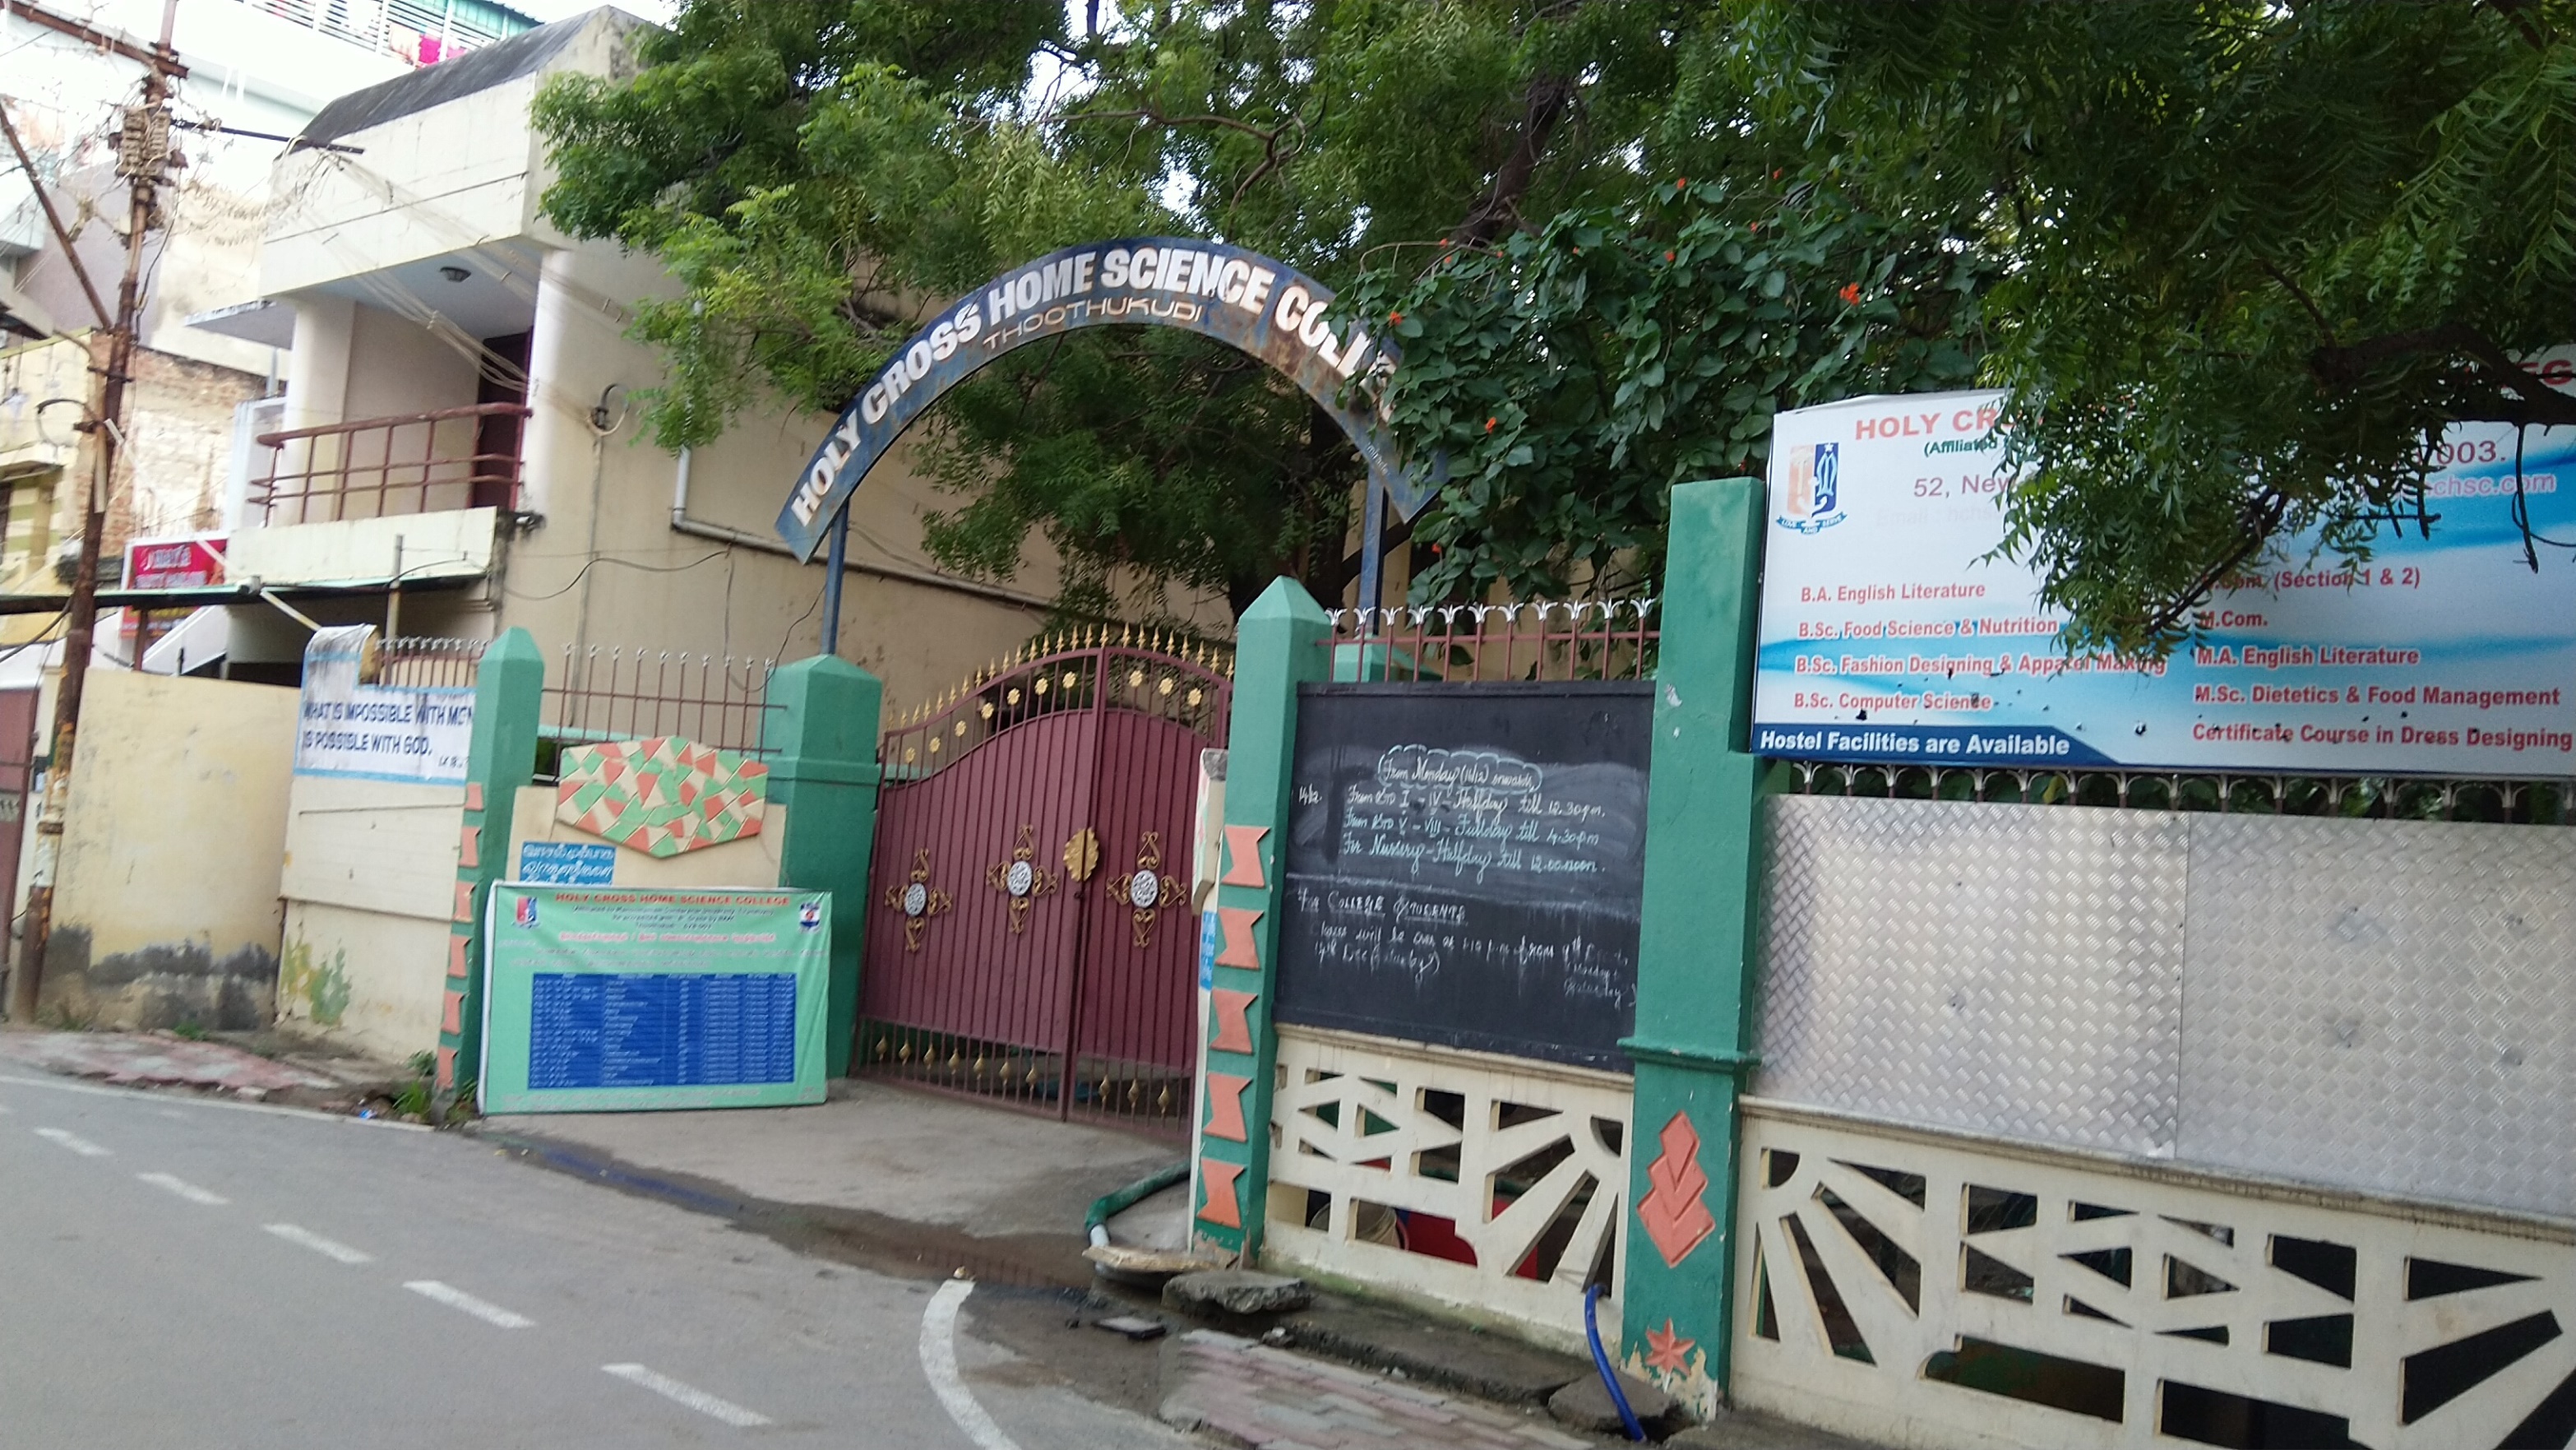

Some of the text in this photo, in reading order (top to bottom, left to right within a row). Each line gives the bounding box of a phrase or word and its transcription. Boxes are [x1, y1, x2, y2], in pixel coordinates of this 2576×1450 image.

[983, 297, 1203, 350] THOOTHUKUDI
[791, 409, 861, 526] HOLY
[862, 302, 982, 424] CROSS
[988, 251, 1097, 327] HOME
[1101, 247, 1275, 315] SCIENCE
[1855, 413, 1941, 440] HOLY
[1914, 477, 1949, 498] 52,
[2274, 570, 2354, 591] (Section
[2380, 568, 2393, 586] &
[2402, 567, 2421, 589] 2)
[1801, 583, 1986, 605] B.A. English Literature
[1799, 617, 2058, 637] B.Sc. Food Science & Nutrition
[2199, 610, 2268, 628] M.Com.
[1797, 657, 1836, 673] B.Sc.
[1842, 656, 1903, 672] Fashion
[1910, 656, 1993, 675] Designing
[2000, 655, 2012, 671] &
[2197, 647, 2419, 669] M.A. English Literature
[1794, 692, 1991, 711] B.Sc. Computer Science
[2195, 685, 2560, 709] M.Sc. Dietetics & Food Management
[303, 702, 331, 720] WHAT
[334, 702, 342, 720] IS
[345, 702, 413, 724] IMPOSSIBLE
[415, 705, 444, 725] WITH
[302, 731, 312, 749] IS
[315, 732, 368, 753] POSSIBLE
[371, 734, 400, 753] WITH
[1760, 730, 2070, 755] Hostel Facilities are Available
[2193, 723, 2573, 753] Certificate Course in Dress Designing
[1412, 756, 1460, 797] Monday
[556, 893, 590, 902] HOLY
[594, 893, 636, 903] CROSS
[640, 894, 675, 904] HOME
[681, 896, 732, 905] SCIENCE
